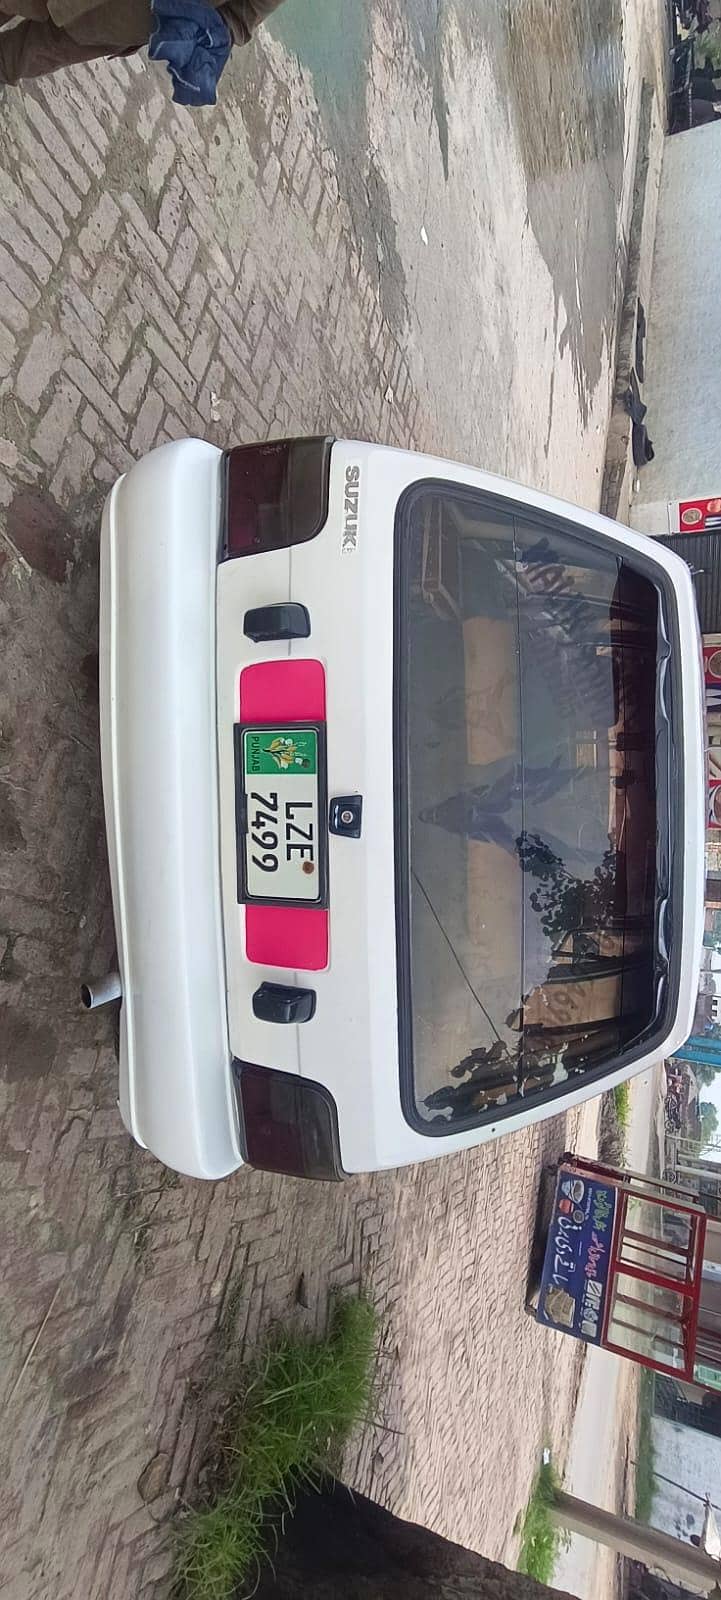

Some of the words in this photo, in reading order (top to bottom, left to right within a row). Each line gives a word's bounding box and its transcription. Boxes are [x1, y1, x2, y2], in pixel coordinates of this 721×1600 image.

[251, 736, 260, 772] PUNJAB
[251, 792, 279, 872] 7499
[285, 802, 314, 861] LZE
